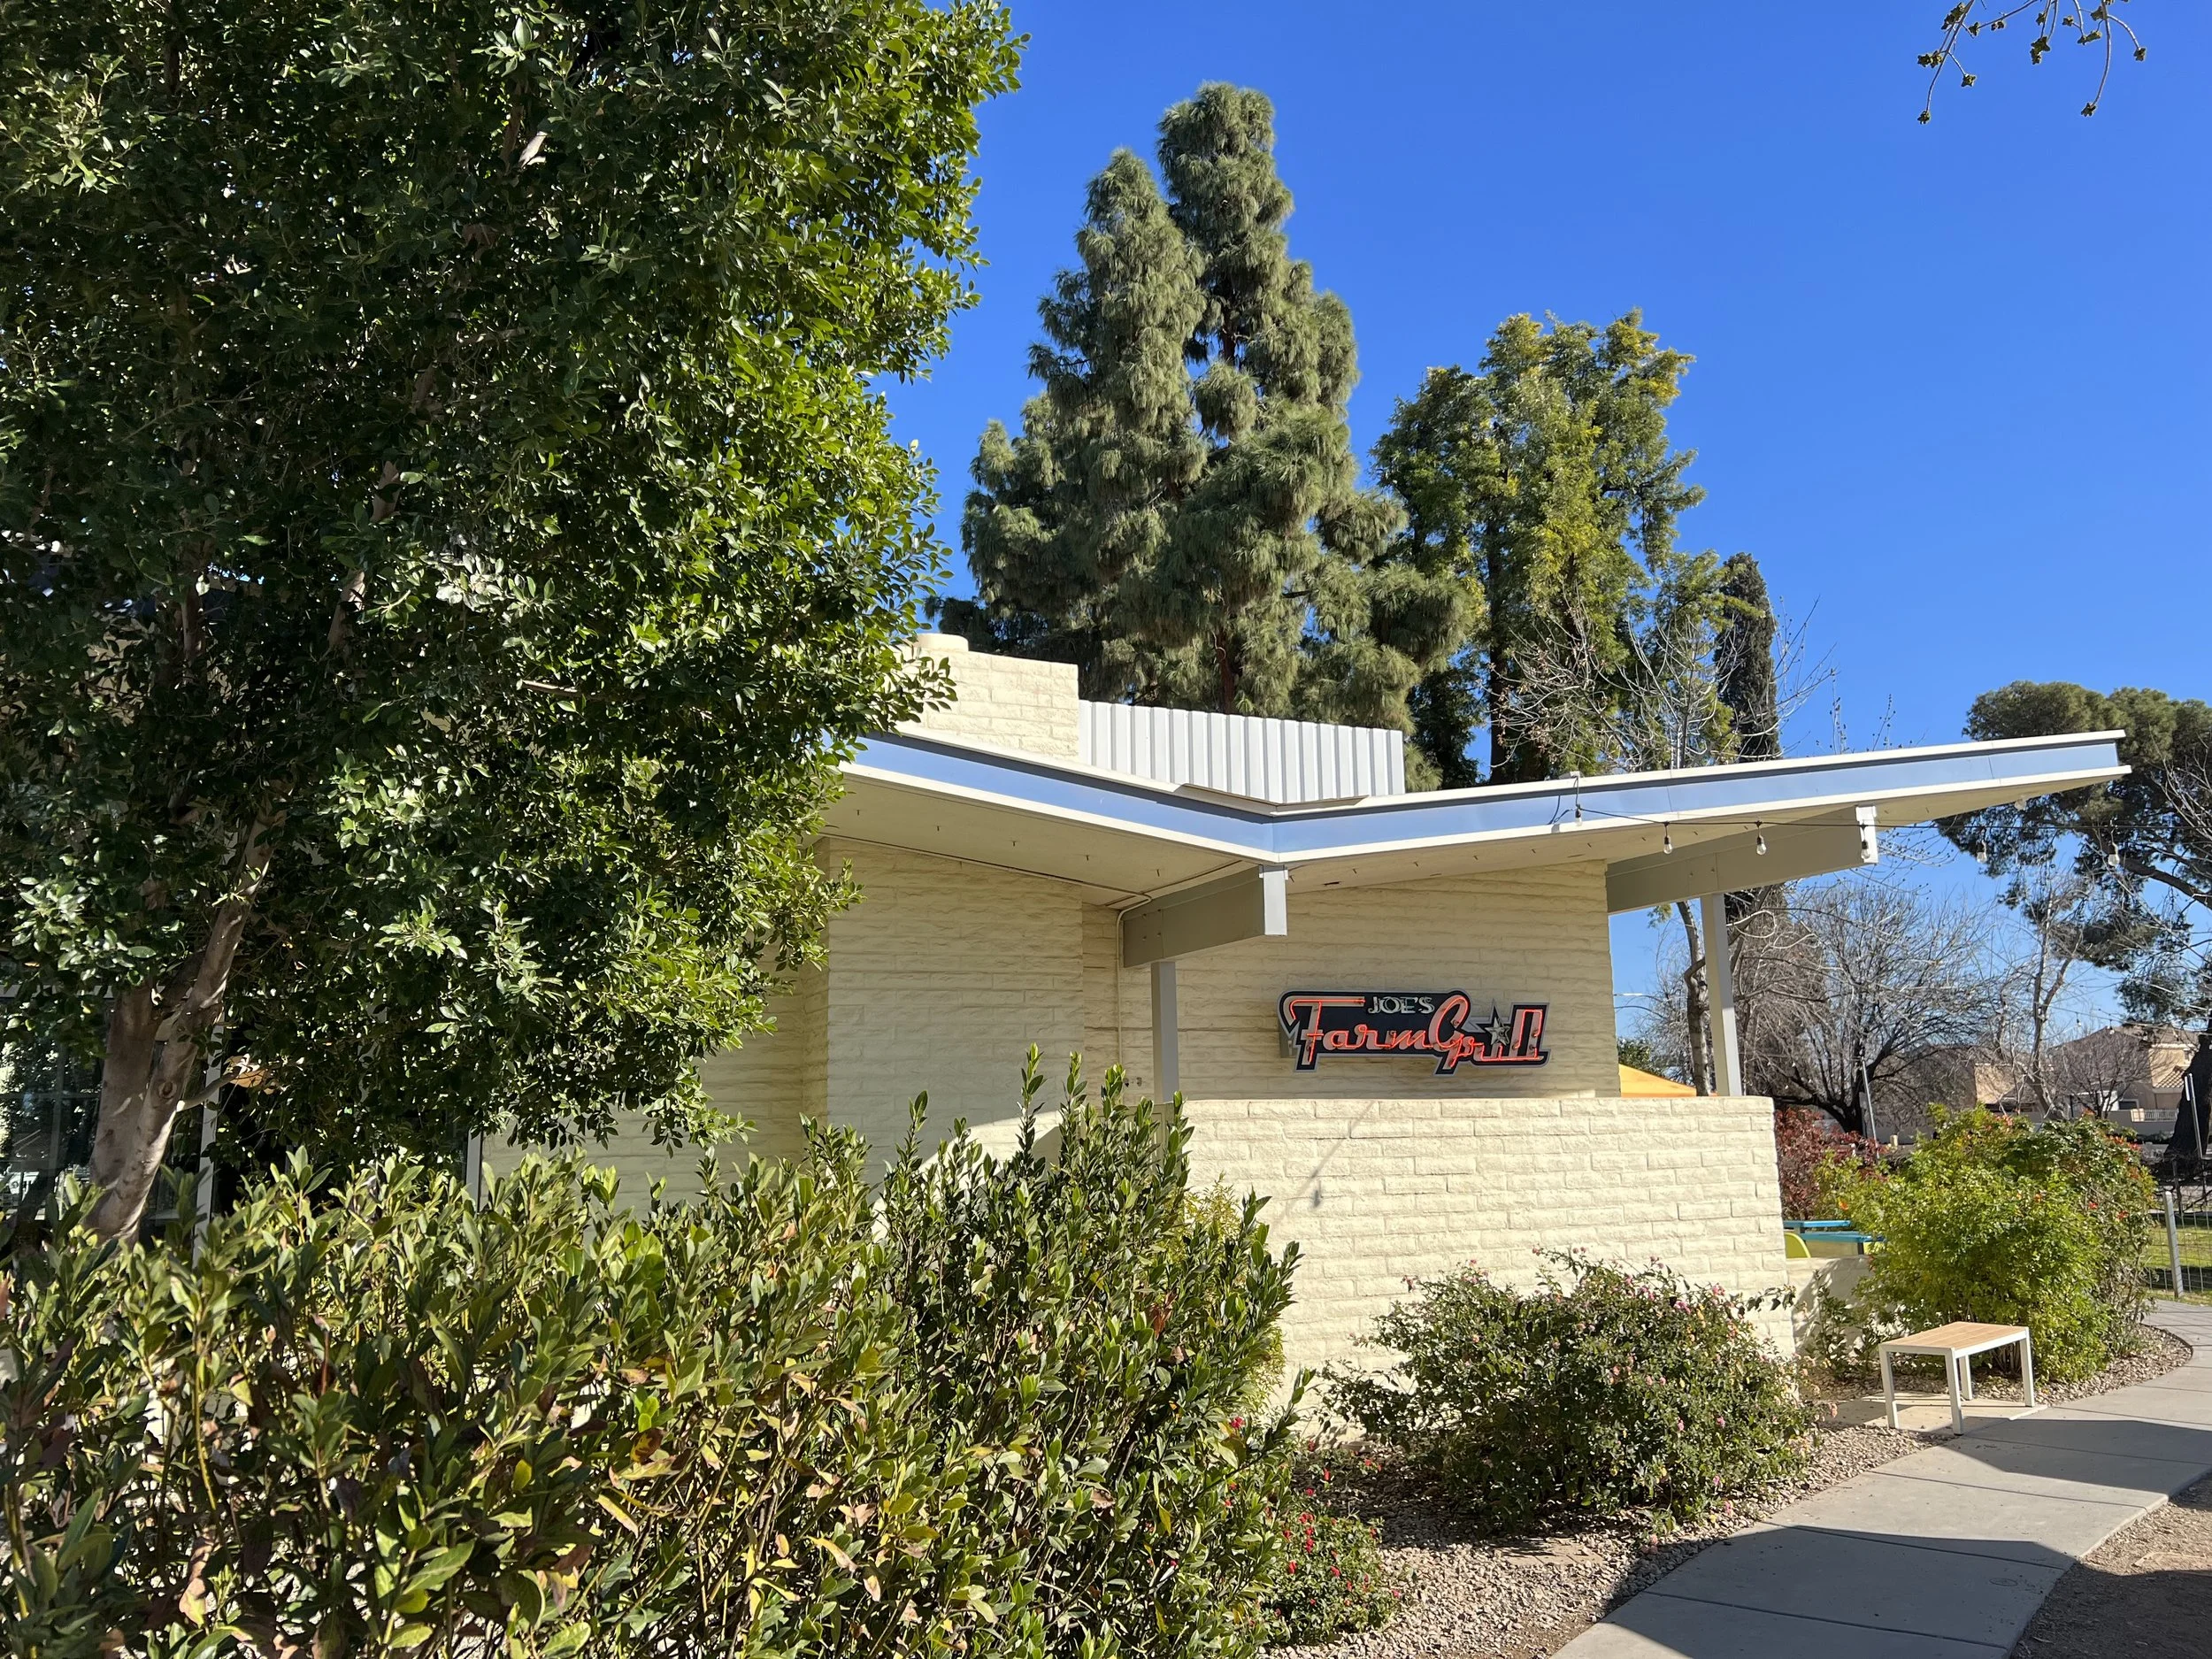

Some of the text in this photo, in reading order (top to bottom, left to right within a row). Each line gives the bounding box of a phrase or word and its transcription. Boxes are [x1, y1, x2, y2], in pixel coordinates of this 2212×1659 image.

[1368, 995, 1435, 1014] JOE'S
[1283, 995, 1544, 1070] Farm Grill
